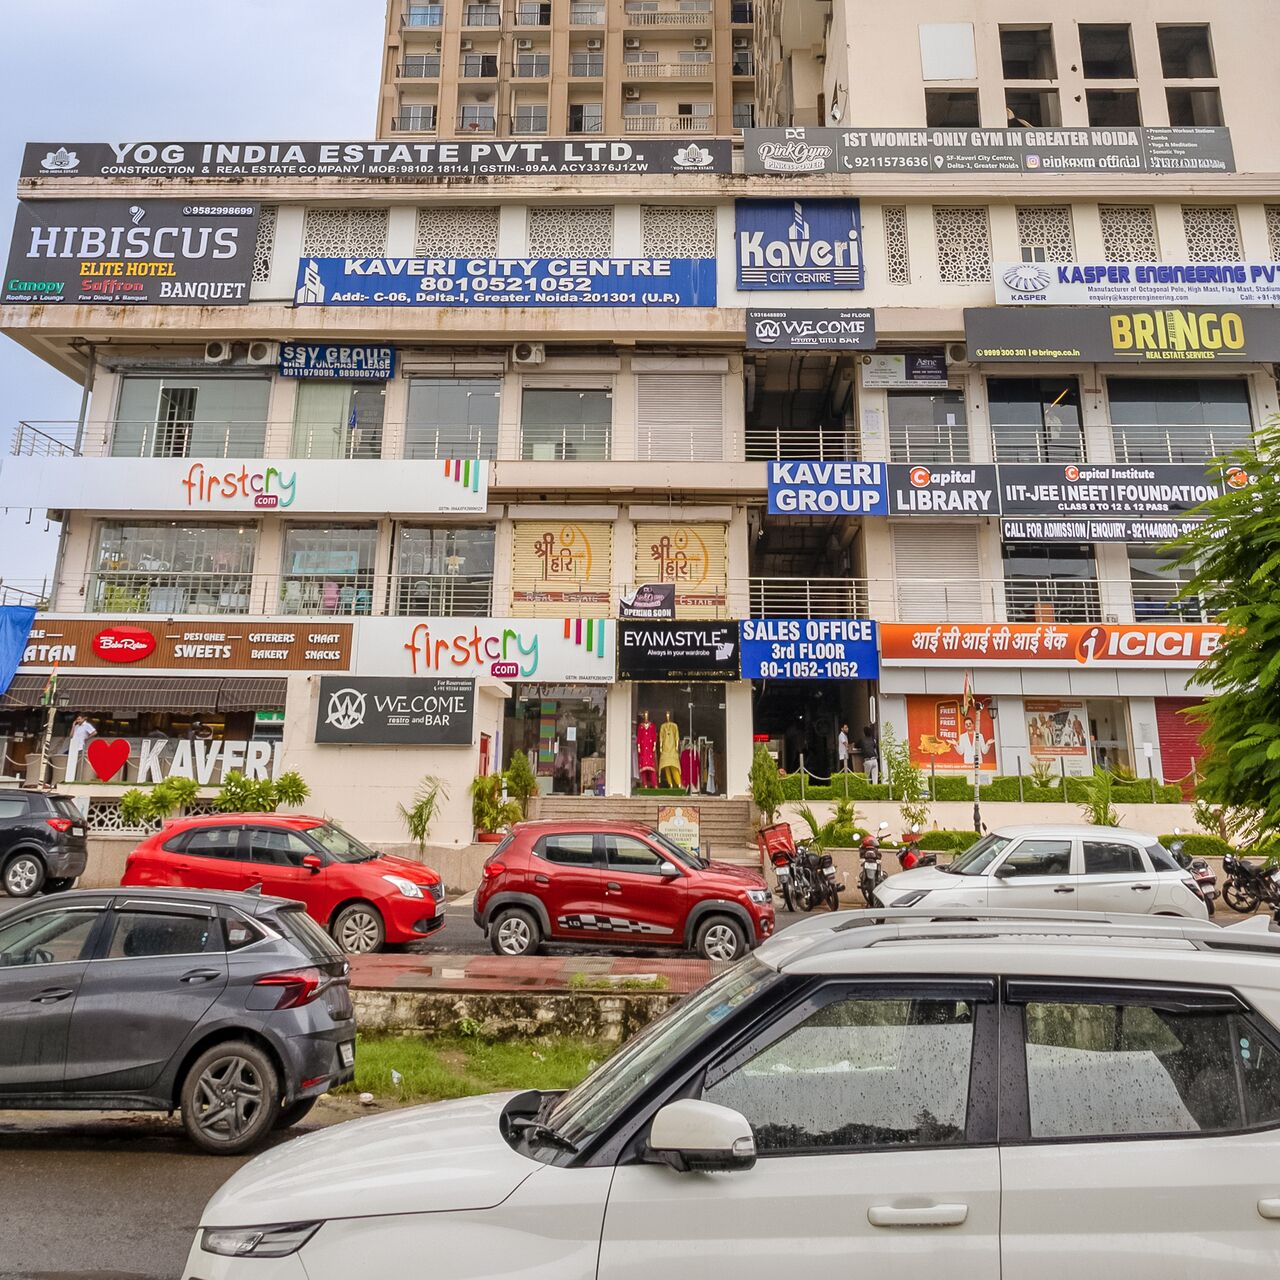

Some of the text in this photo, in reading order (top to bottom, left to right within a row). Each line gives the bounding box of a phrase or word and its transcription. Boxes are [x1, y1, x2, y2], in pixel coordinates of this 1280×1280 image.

[842, 131, 1139, 147] 1ST WOMEN-ONLY GYM IN GREATER NOIDA
[109, 142, 645, 164] YOG INDIA ESTATE PVT. LTD.
[101, 164, 469, 174] CONSTRUCTION & REAL ESTATE COMPANY MOB:98102 18114
[854, 157, 929, 167] 9211573636
[192, 207, 253, 215] 9582998699
[26, 227, 239, 259] HIBISCUS
[740, 229, 859, 267] Kaveri
[80, 262, 177, 276] ELITE HOTEL
[344, 259, 671, 276] KAVERI CITY CENTRE
[1058, 266, 1131, 284] KASPER
[1136, 265, 1247, 284] ENGINEERING
[420, 277, 592, 292] 8010521052
[770, 271, 831, 283] CITY CENTRE
[7, 279, 65, 294] Canopy
[81, 279, 144, 294] Saffron
[160, 282, 246, 300] BANQUET
[331, 292, 680, 305] Add:- C-06, Greater Noida-201301 (U.P.)
[1089, 294, 1189, 302] enquiry@kasperengineering.com
[1109, 309, 1246, 351] BRINGO
[983, 349, 1001, 357] 9999
[1001, 349, 1014, 357] 300
[1038, 349, 1081, 358] bringo.co.in
[1146, 351, 1216, 359] REAL ESTATE SERVICES
[363, 360, 391, 369] LEASE
[772, 463, 881, 485] KAVERI
[909, 465, 976, 488] Capital
[1064, 465, 1155, 482] Capital Institute
[182, 463, 297, 508] firstcry
[1006, 484, 1218, 502] IIT-JEE NEET FOUNDATION
[255, 496, 277, 505] .com
[776, 489, 880, 512] GROUP
[896, 489, 992, 511] LIBRARY
[1058, 503, 1169, 511] CLASS TO 12 & 12 PASS
[1004, 523, 1042, 538] CALL FOR
[624, 608, 672, 617] OPENING SOON
[184, 633, 226, 641] DESI GHEE
[248, 633, 296, 643] CATERERS
[308, 633, 341, 643] CHAAT
[743, 620, 872, 641] SALES OFFICE
[624, 631, 721, 646] EYANASTYLE
[911, 626, 1068, 654] आई सी आई सी आई बैंक
[1108, 631, 1194, 656] ICICI
[20, 644, 77, 663] ATAN
[174, 644, 232, 659] SWEETS
[251, 650, 289, 660] BAKERY
[305, 650, 341, 660] SNACKS
[404, 623, 539, 677] firstcry
[647, 649, 666, 657] Always
[771, 643, 845, 660] 3rd FLOOR
[492, 664, 517, 675] .com
[760, 661, 859, 678] 80-1052-1052
[425, 715, 450, 726] BAR
[940, 731, 957, 739] FREE!
